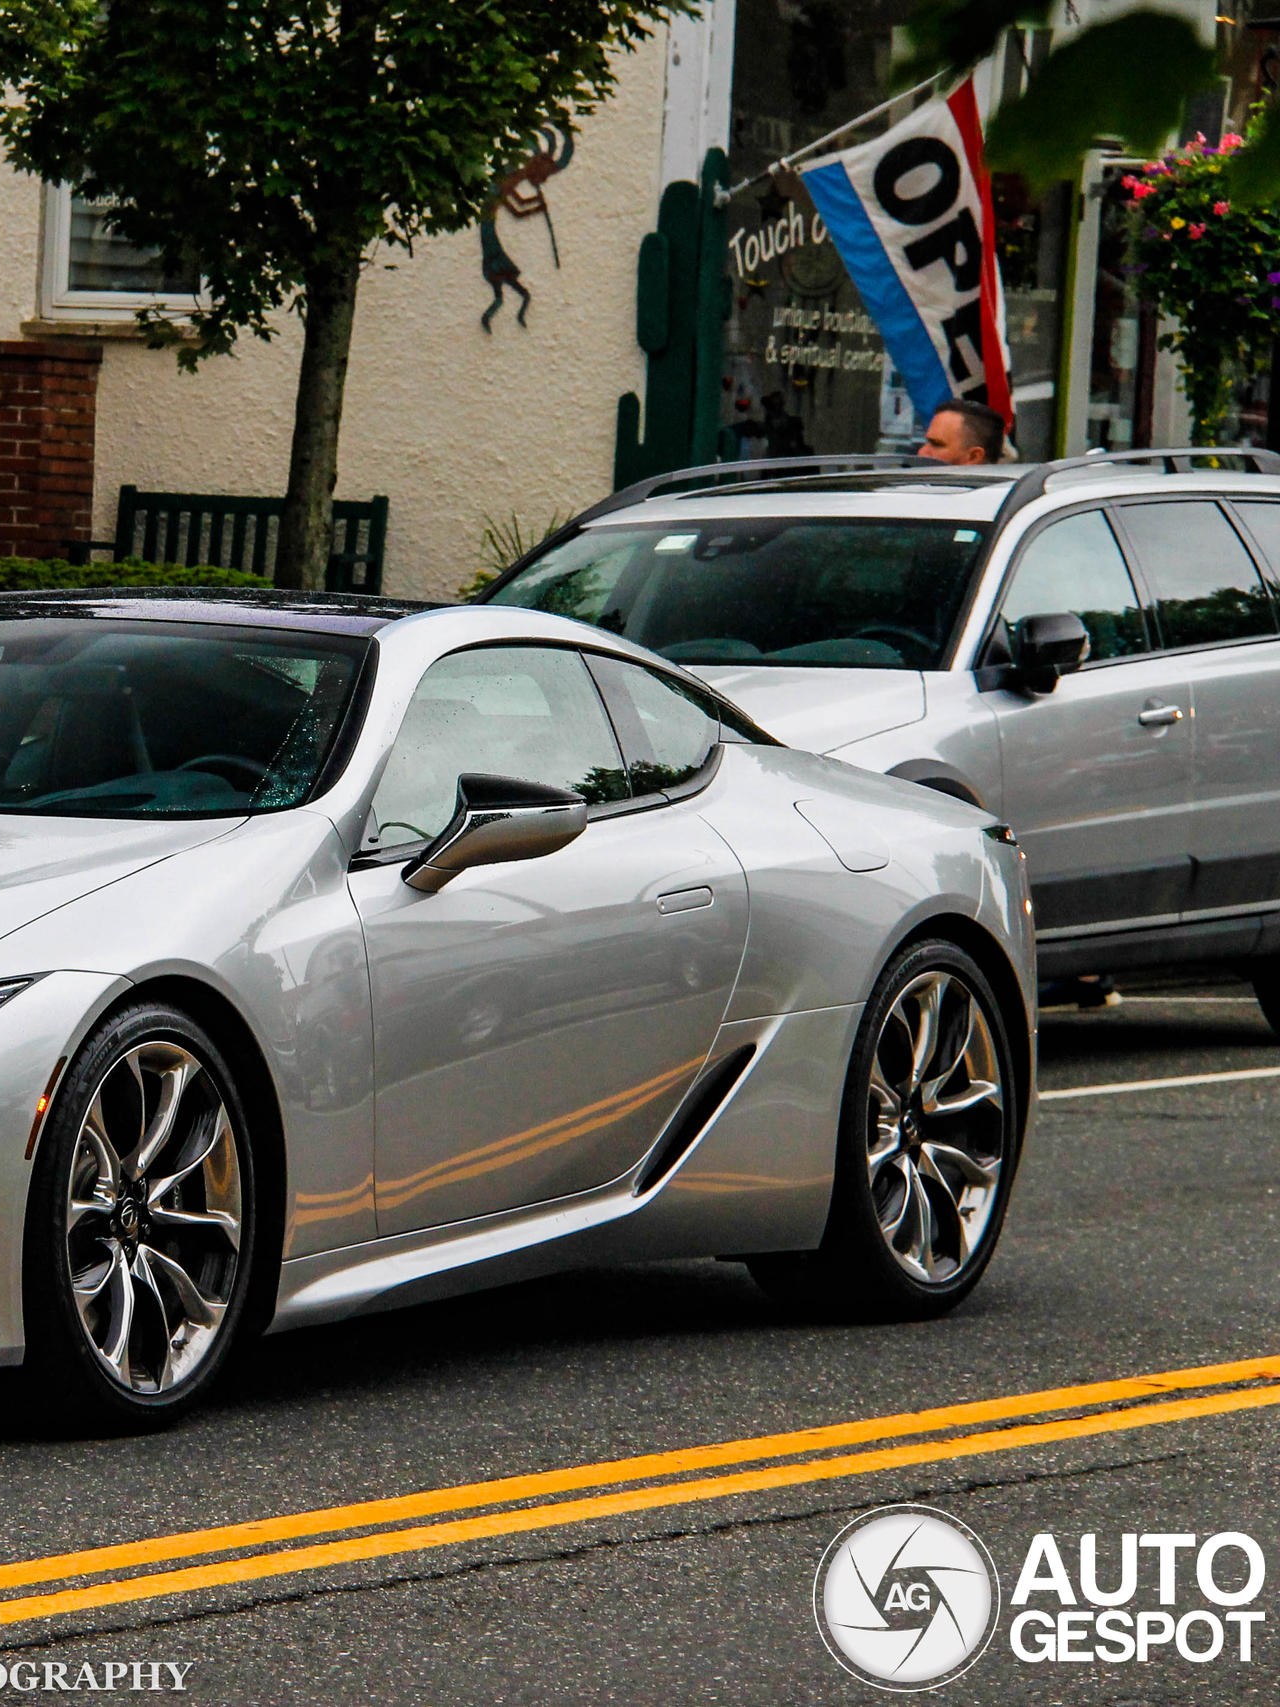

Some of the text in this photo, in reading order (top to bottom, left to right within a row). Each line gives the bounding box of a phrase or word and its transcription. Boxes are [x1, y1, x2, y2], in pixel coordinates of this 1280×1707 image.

[728, 200, 829, 278] Touch o
[874, 136, 988, 406] OPE
[766, 335, 778, 364] &
[780, 341, 841, 376] spiritual
